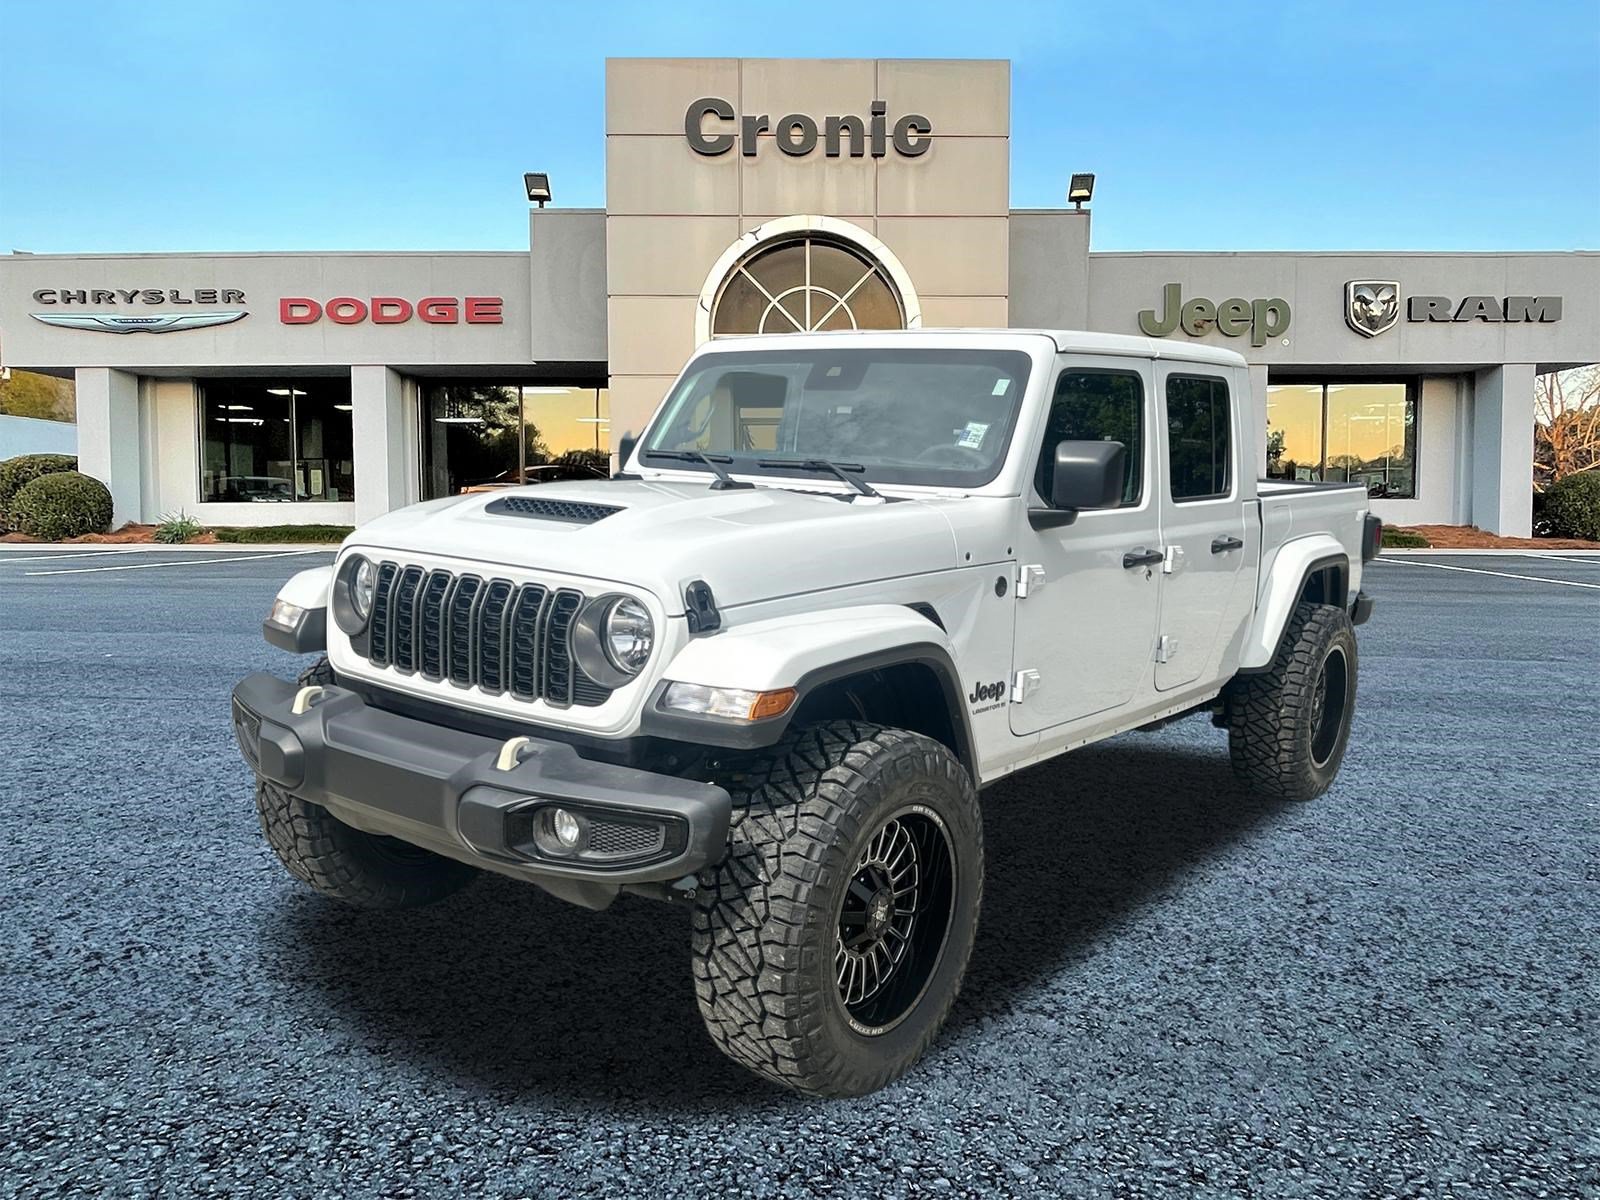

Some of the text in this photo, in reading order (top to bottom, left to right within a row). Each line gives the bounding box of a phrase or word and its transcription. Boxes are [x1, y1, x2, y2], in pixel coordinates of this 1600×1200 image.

[685, 97, 933, 157] Cronic
[32, 288, 247, 305] CHRYSLER
[279, 296, 504, 324] DODGE
[1408, 295, 1563, 323] RAM
[1138, 283, 1291, 347] Jeep
[969, 680, 1006, 704] Jeep
